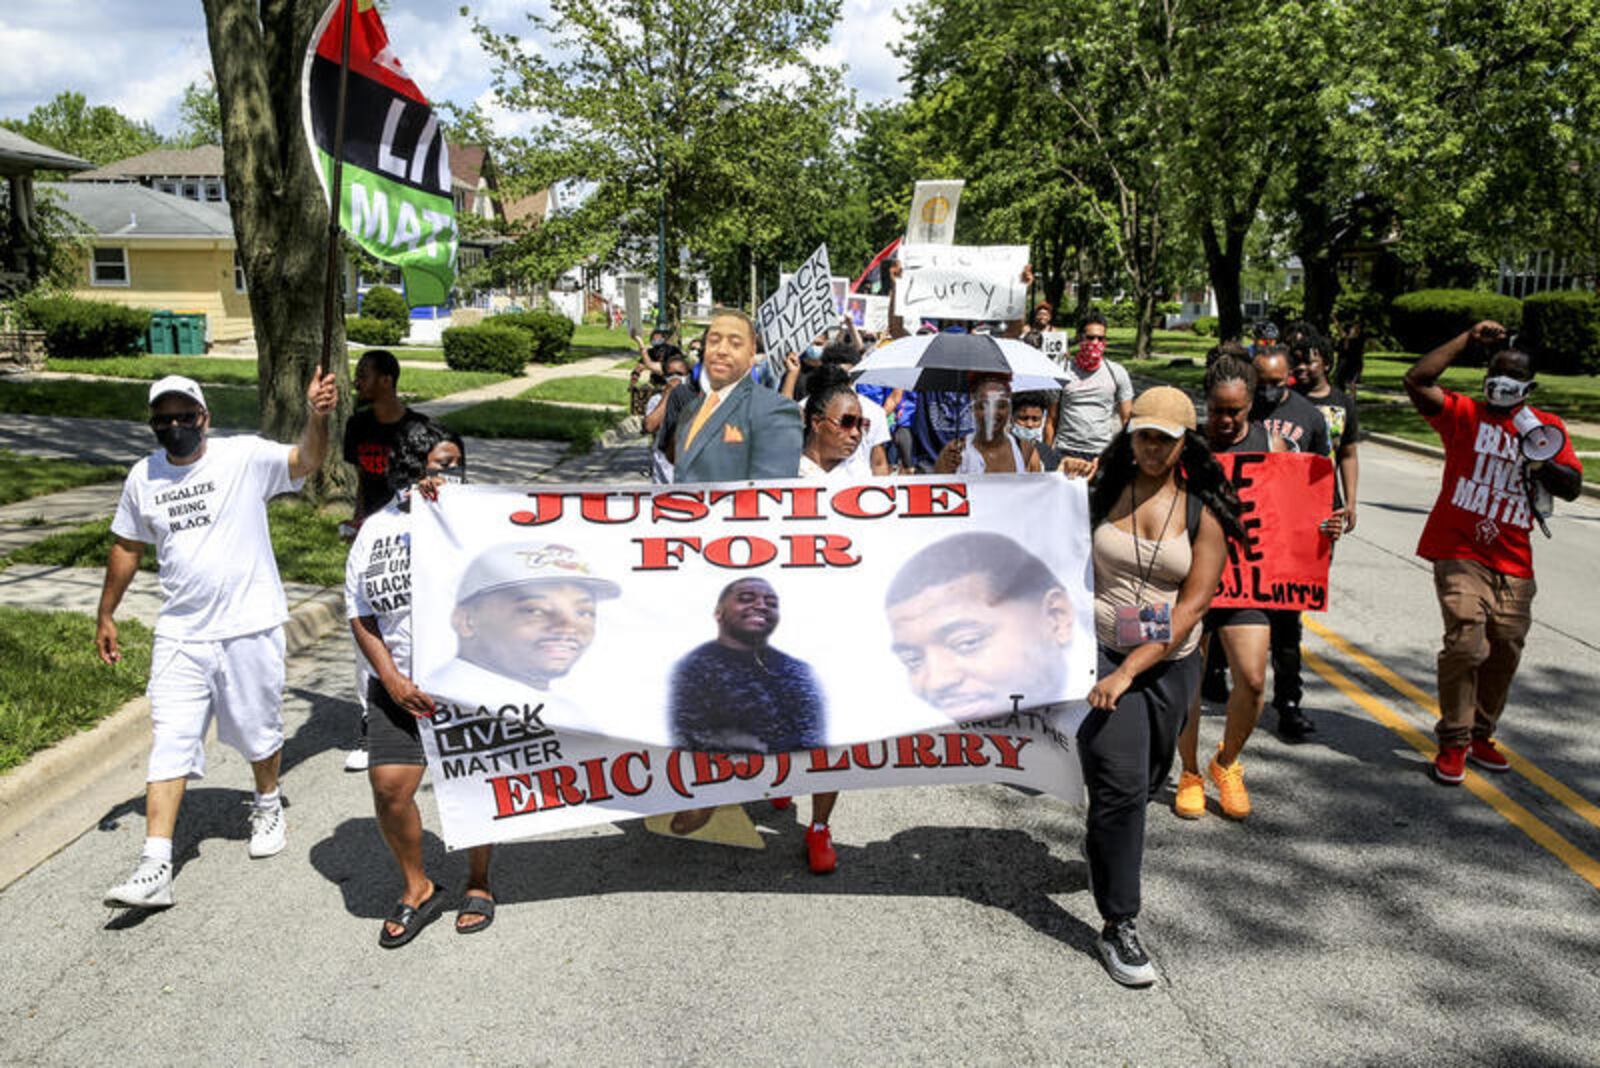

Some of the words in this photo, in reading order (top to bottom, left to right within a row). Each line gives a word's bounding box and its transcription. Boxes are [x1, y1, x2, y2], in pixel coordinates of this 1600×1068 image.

[760, 249, 826, 328] BLACK
[765, 274, 832, 350] LIVES
[769, 299, 836, 377] MATTER
[155, 480, 215, 505] LEGALIZE
[168, 499, 206, 517] BEING
[509, 483, 970, 526] JUSTICE
[169, 514, 211, 533] BLACK
[631, 534, 863, 571] FOR
[365, 573, 412, 599] BLACK
[1251, 566, 1325, 610] Lurry
[442, 740, 563, 779] MATTER
[486, 750, 653, 820] ERIC
[806, 732, 1033, 773] LURRY
